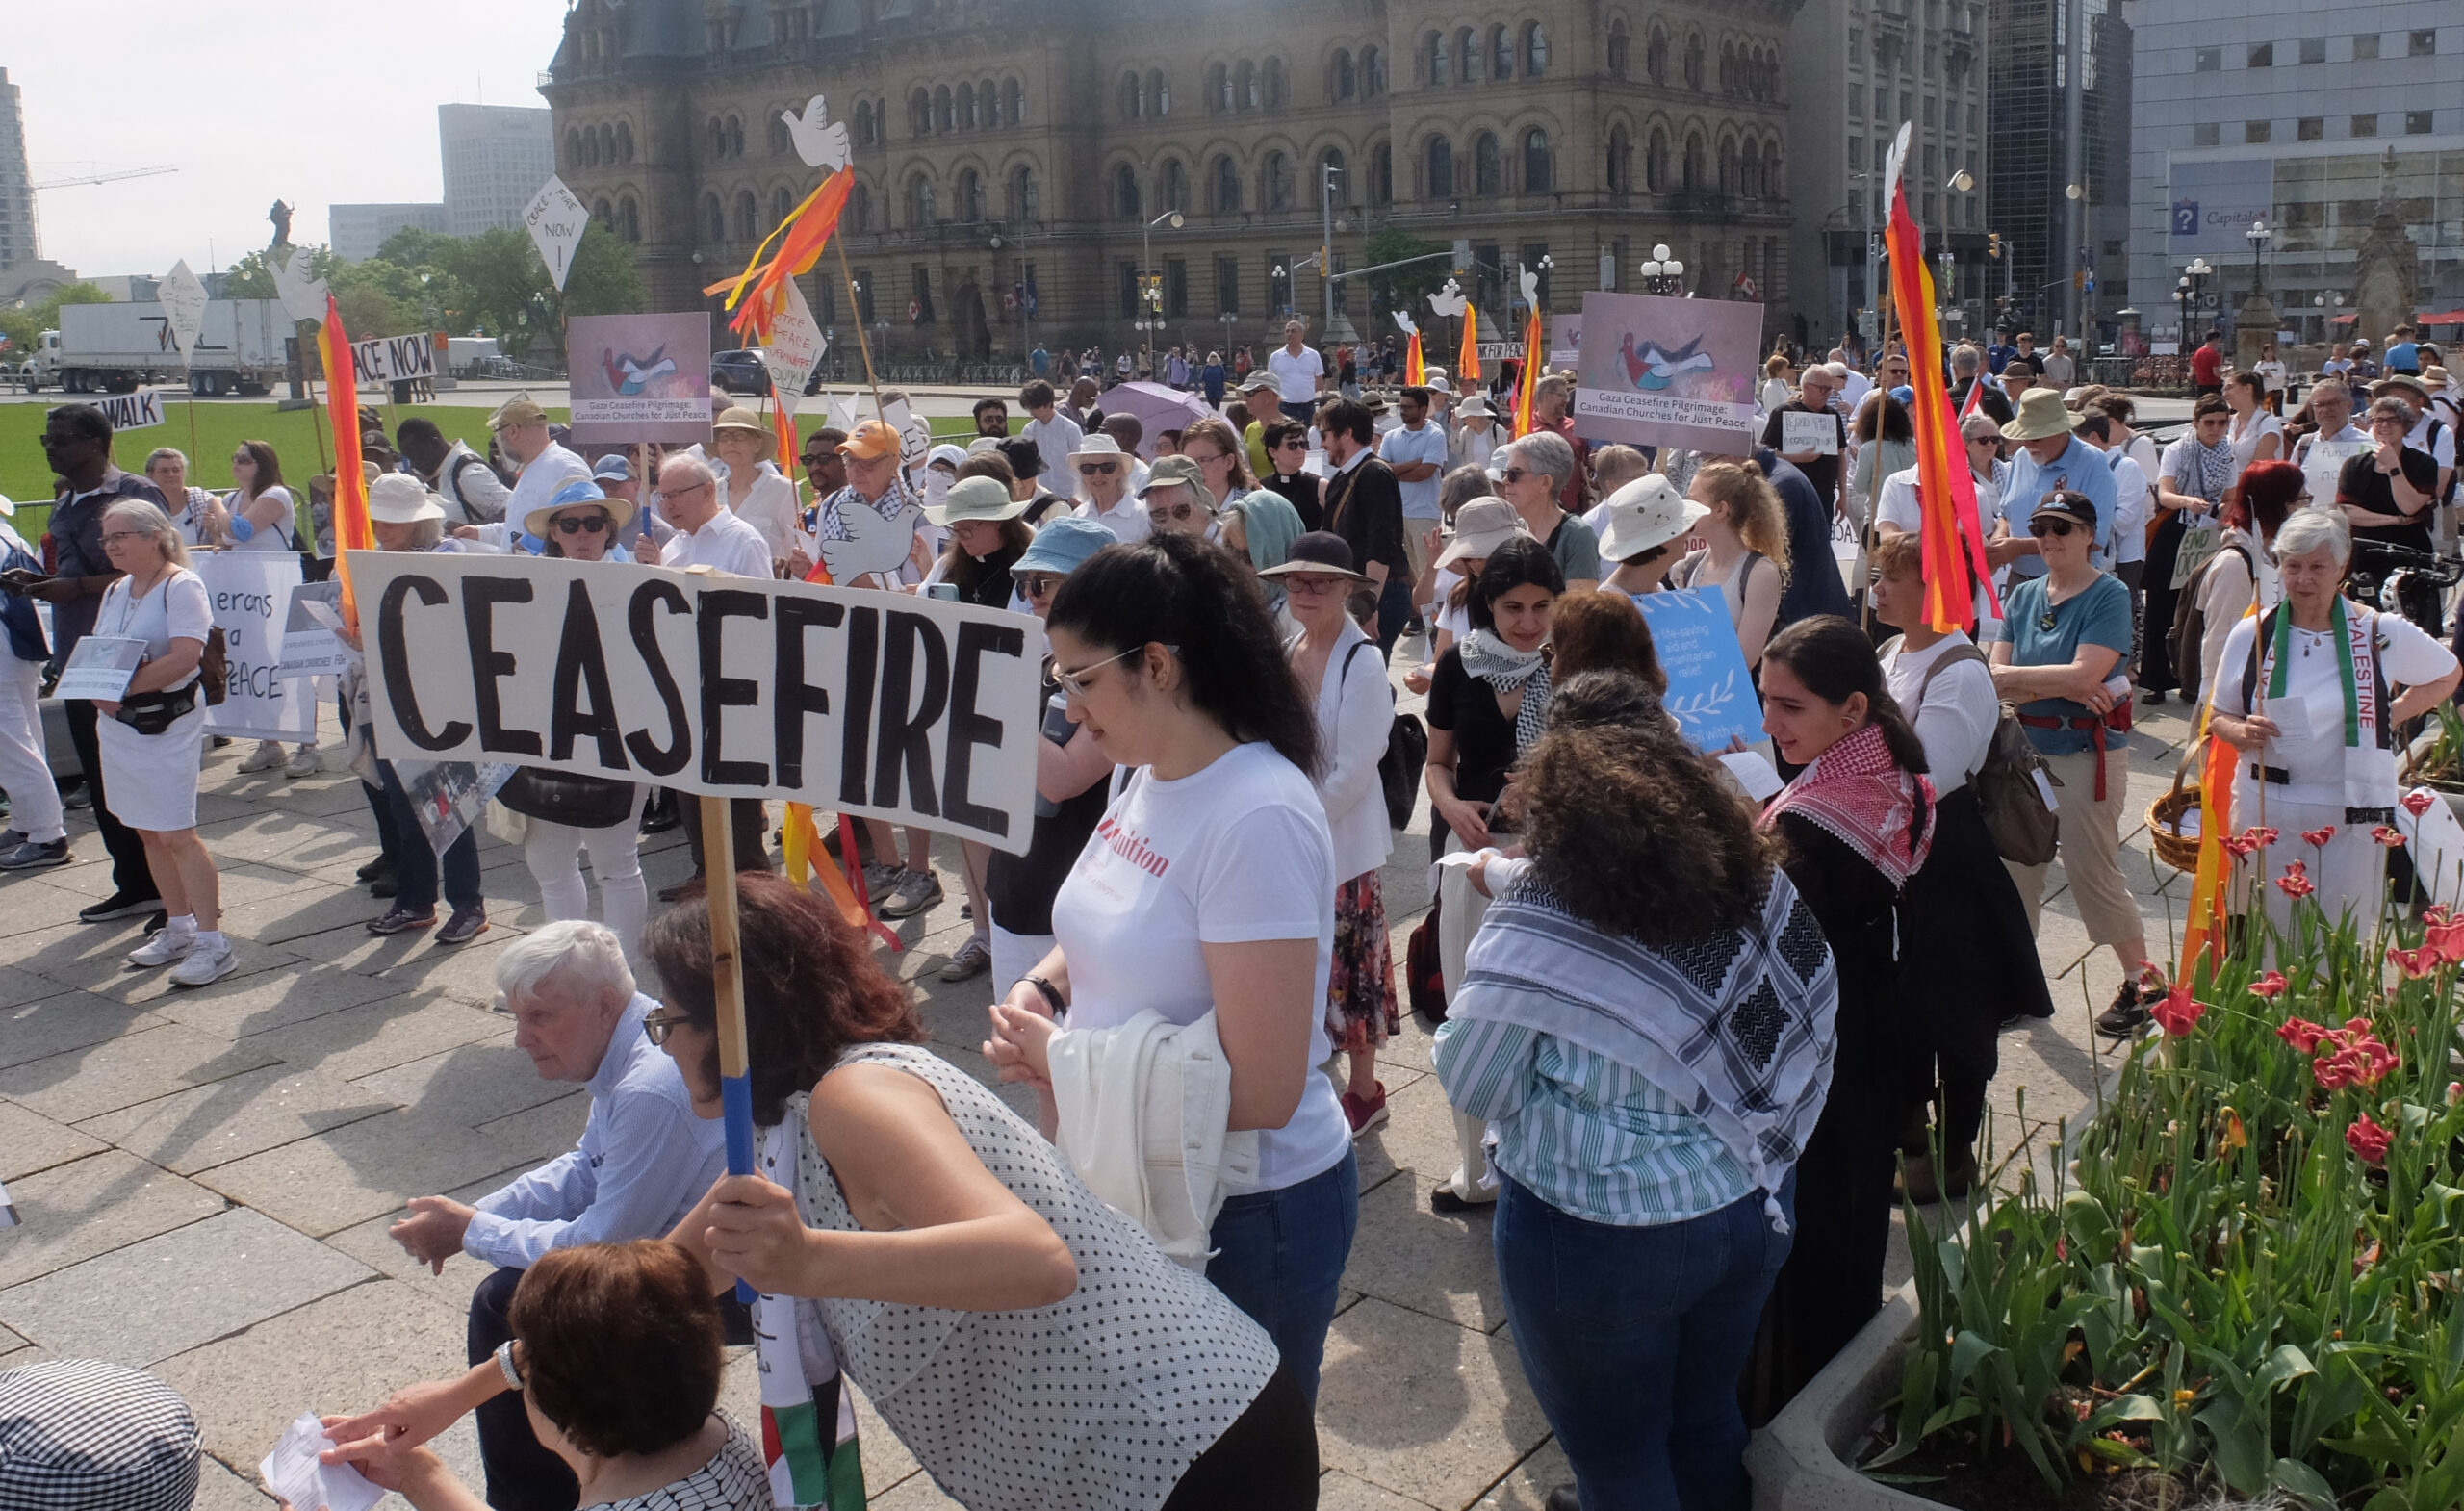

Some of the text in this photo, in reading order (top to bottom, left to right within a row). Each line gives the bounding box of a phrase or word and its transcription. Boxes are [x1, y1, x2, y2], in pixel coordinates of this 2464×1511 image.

[544, 222, 575, 237] NOW
[350, 335, 431, 383] ACE NOW
[102, 393, 157, 429] WALK
[589, 400, 692, 411] Gaza Ceasefire Pilgrimage:
[1599, 392, 1728, 415] Gaza Ceasefire Pilgrimage:
[664, 411, 681, 420] Just
[1579, 402, 1746, 428] Canadian Churches for Just Peace
[2322, 446, 2350, 458] fund
[2182, 529, 2210, 551] END
[1663, 650, 1716, 667] umanitarian
[2348, 617, 2374, 729] PALESTINE
[378, 575, 1025, 838] CEASEFIRE
[1707, 725, 1730, 740] with
